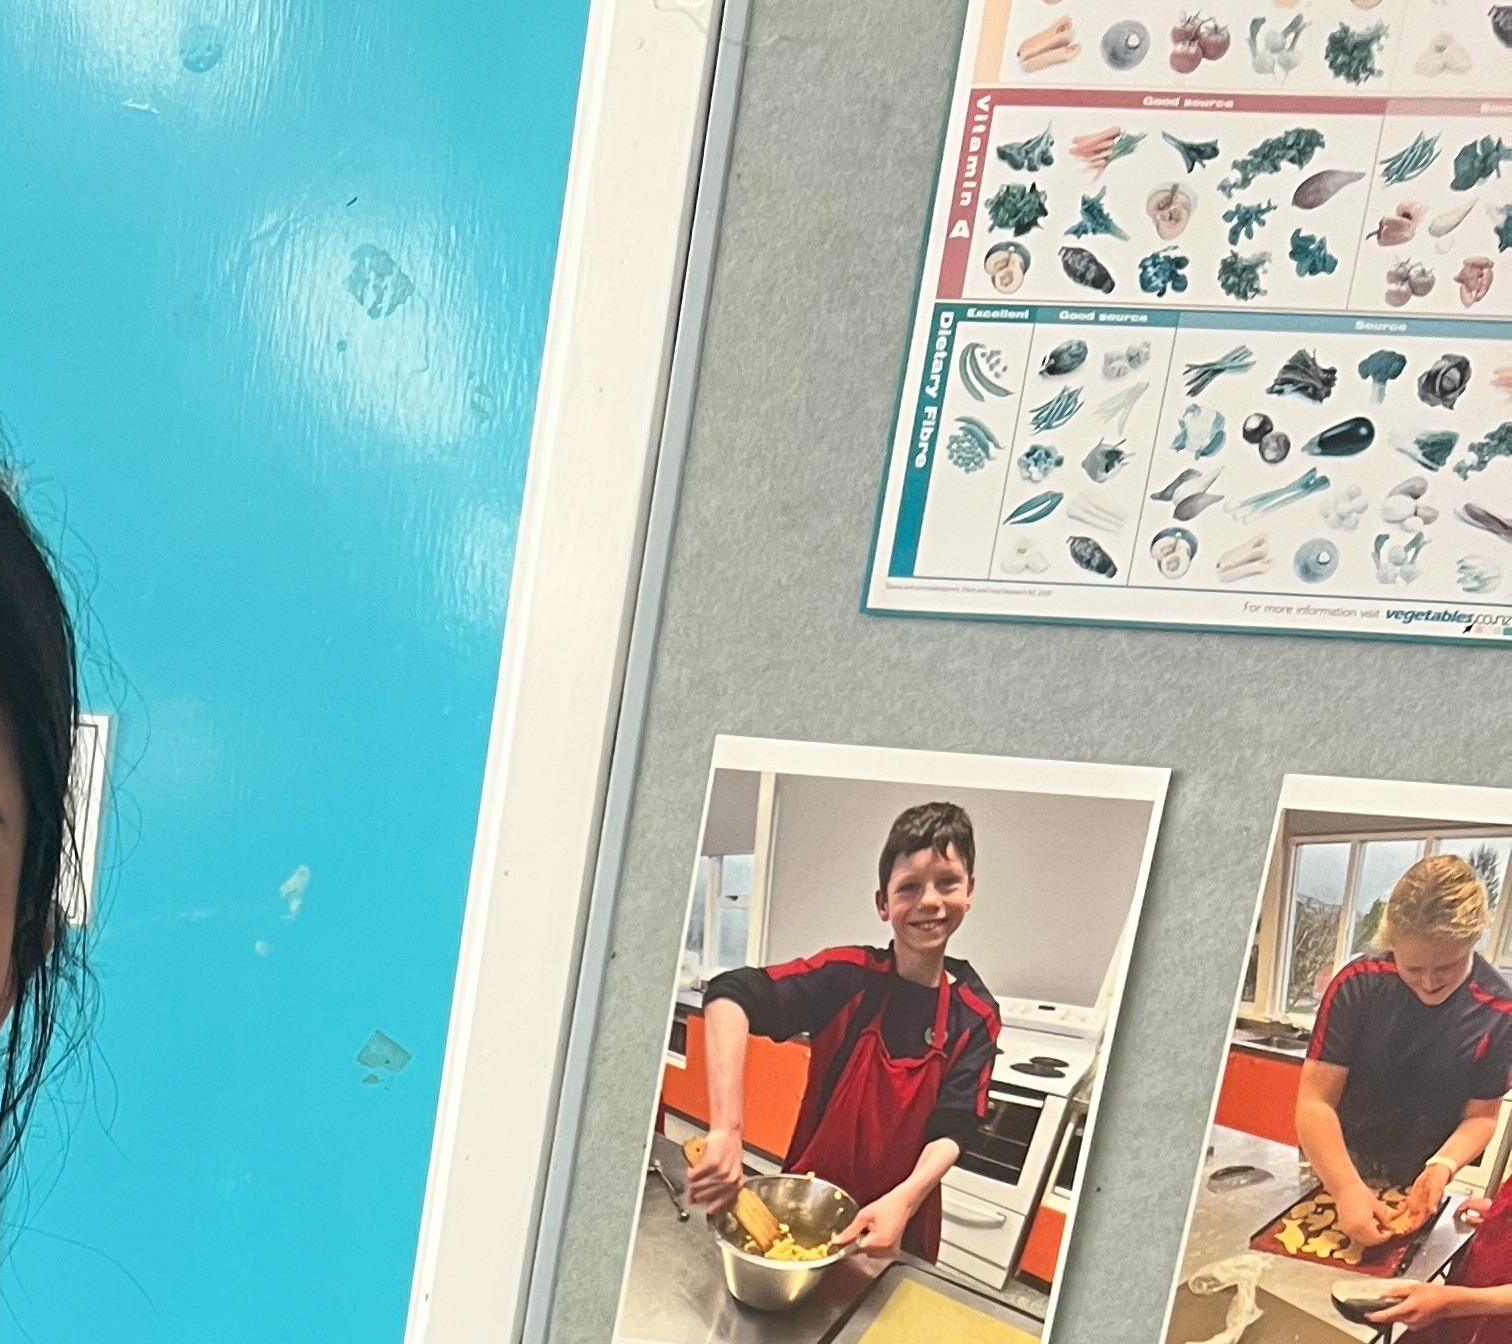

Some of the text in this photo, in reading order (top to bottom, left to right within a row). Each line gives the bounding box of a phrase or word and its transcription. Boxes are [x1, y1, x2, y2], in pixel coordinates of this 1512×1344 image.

[948, 95, 992, 238] Vitamin A
[1058, 309, 1096, 322] Good
[914, 310, 955, 469] Dietary Fibre
[1243, 601, 1262, 613] For
[1263, 604, 1294, 615] more
